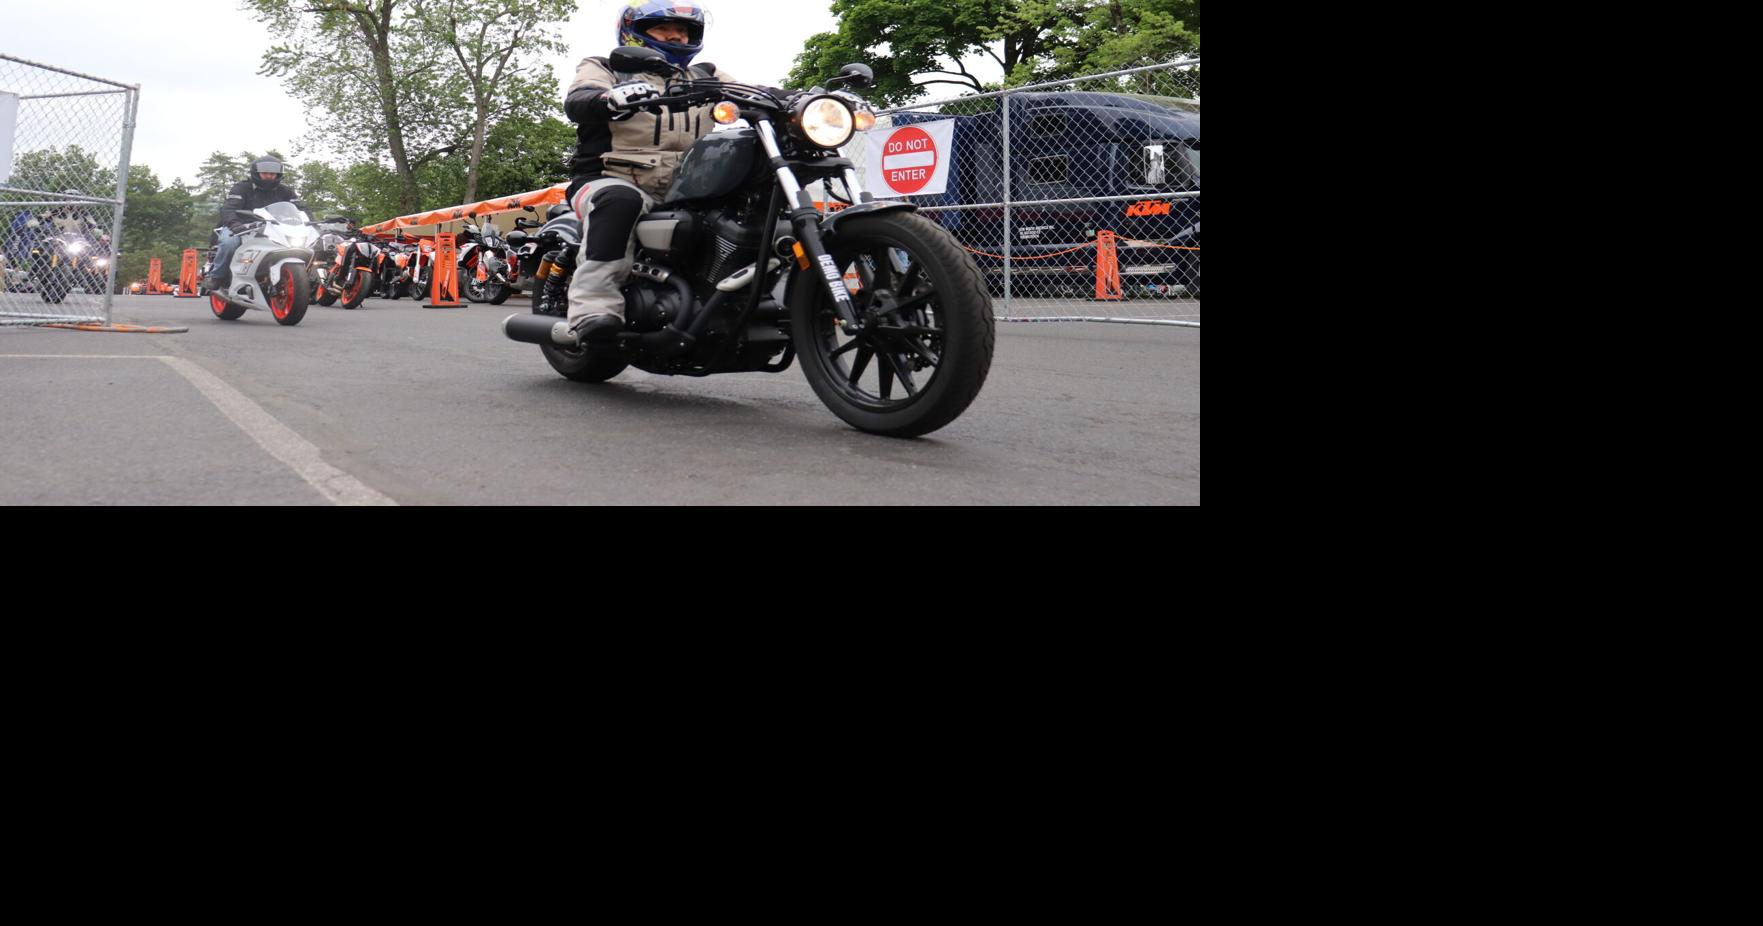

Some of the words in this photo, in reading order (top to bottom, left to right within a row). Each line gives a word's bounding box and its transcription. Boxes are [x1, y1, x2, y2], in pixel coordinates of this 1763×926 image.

[888, 141, 903, 153] DO
[906, 138, 929, 151] NOT
[891, 168, 926, 182] ENTER
[1126, 200, 1170, 217] KTM
[817, 254, 841, 280] DEMO
[828, 280, 851, 303] BIKE
